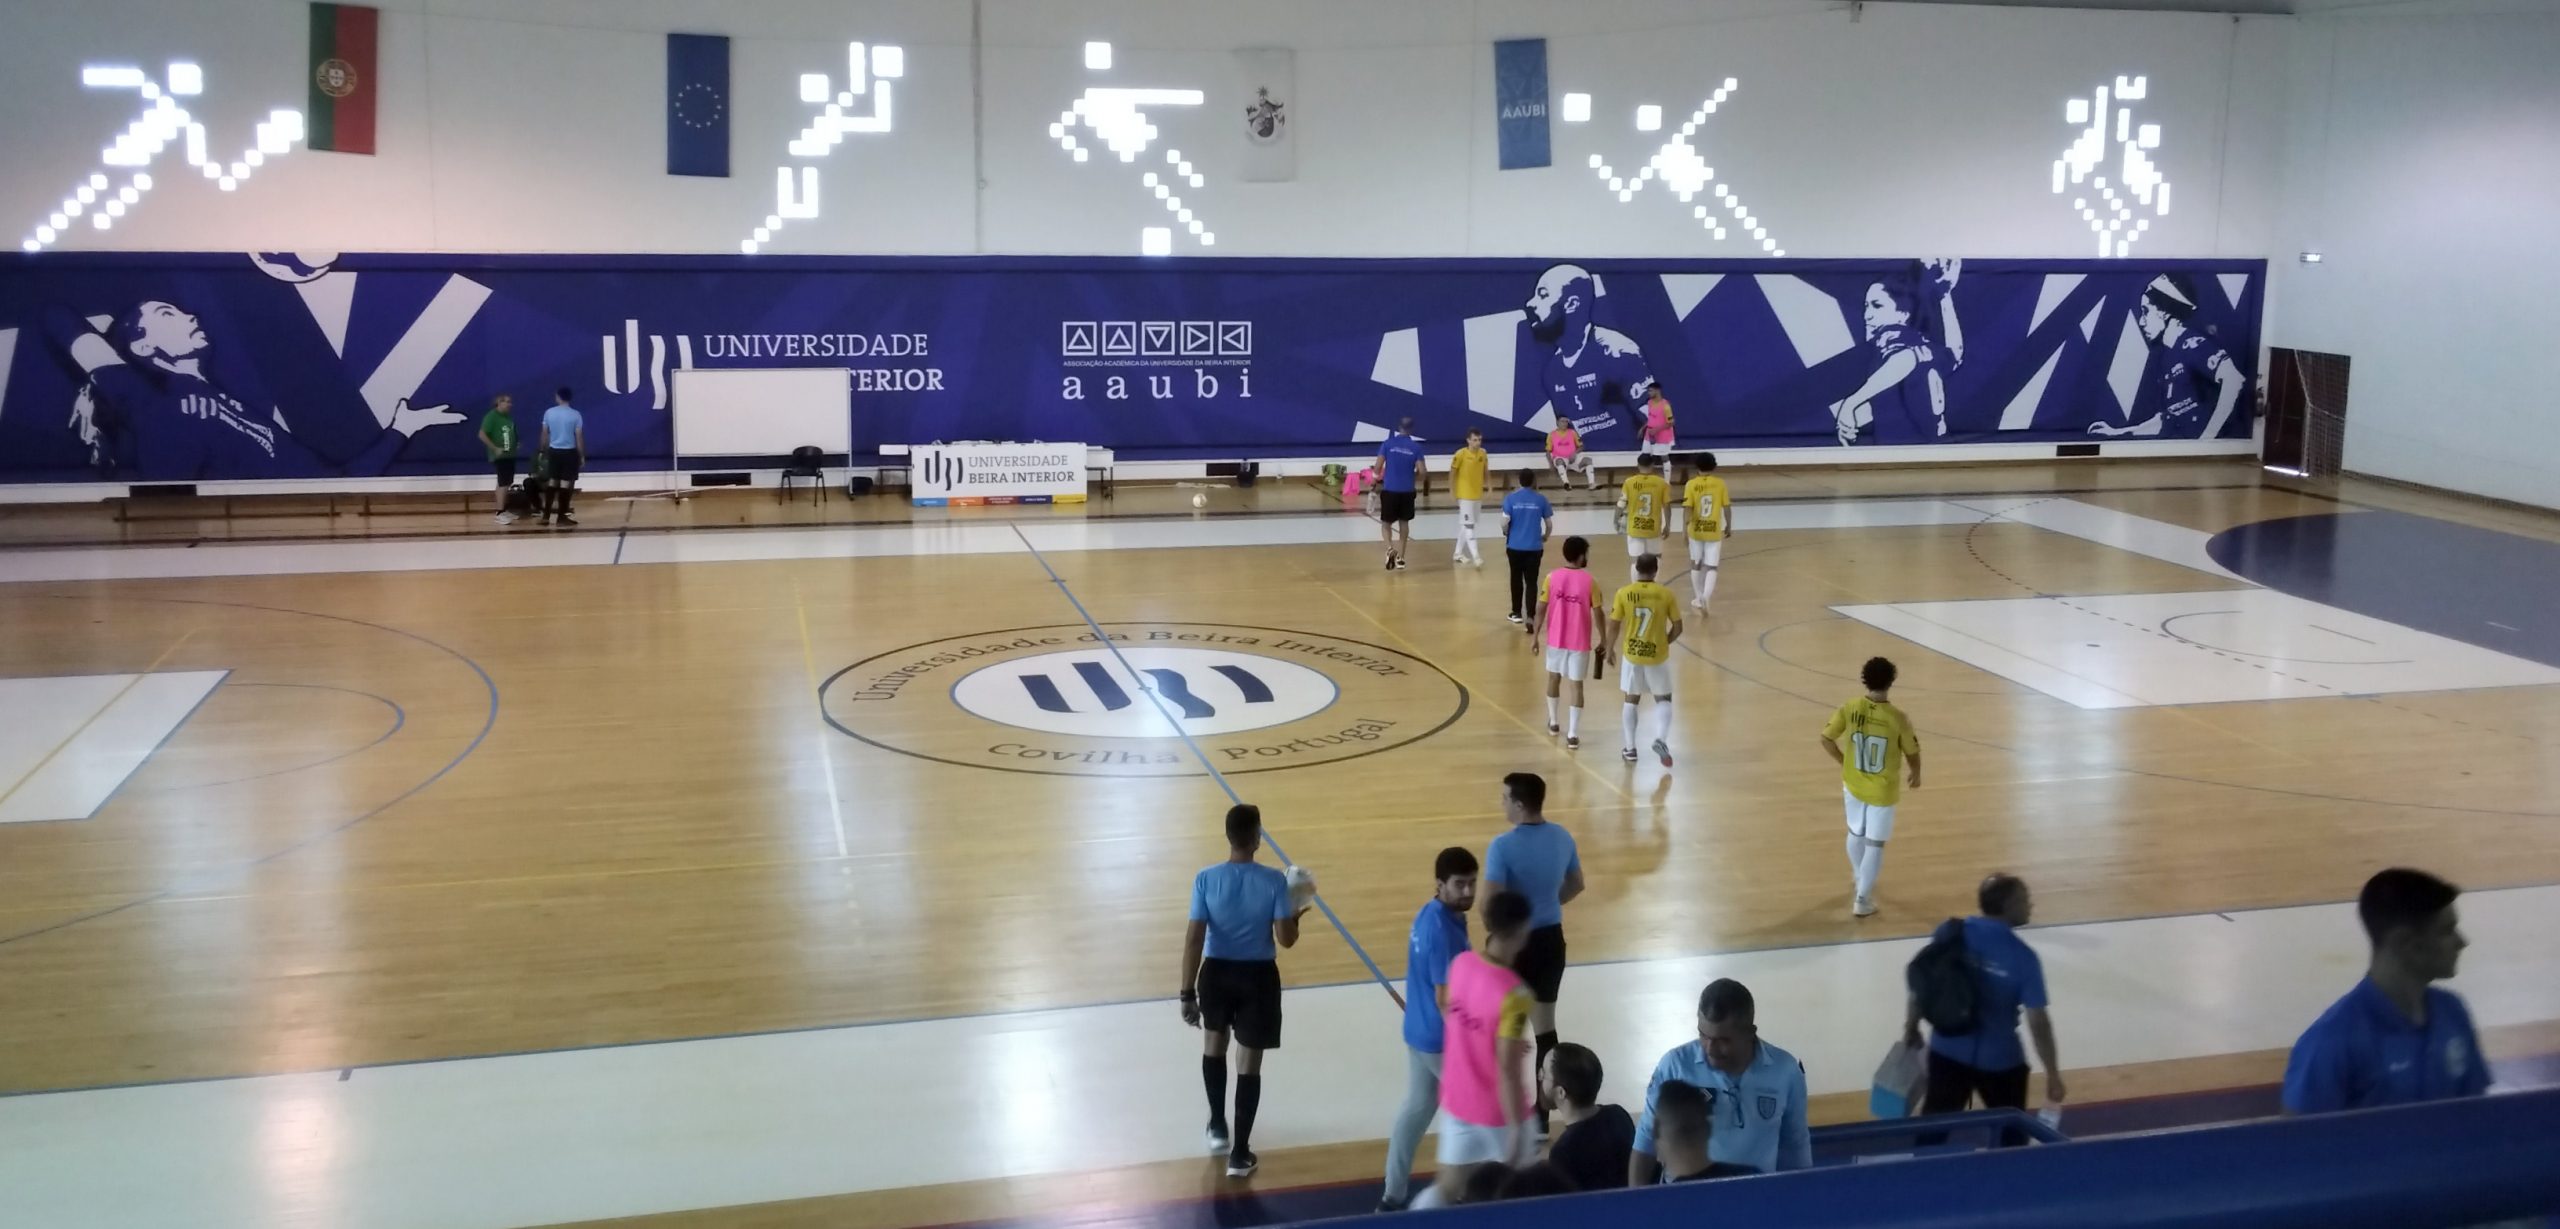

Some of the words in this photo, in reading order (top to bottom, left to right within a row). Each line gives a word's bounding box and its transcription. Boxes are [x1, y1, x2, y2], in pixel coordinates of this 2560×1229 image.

[1502, 104, 1546, 118] AAUBI
[704, 333, 929, 357] UNIVERSIDADE
[968, 455, 1069, 468] UNIVERSIDADE
[968, 473, 1009, 484] BEIRA
[1012, 471, 1075, 482] INTERIOR
[1638, 493, 1652, 517] 3
[1635, 607, 1654, 637] 7
[852, 636, 1066, 701] Universidade
[1077, 632, 1130, 643] da
[1147, 631, 1261, 645] Beira
[1270, 639, 1409, 676] Interior
[1217, 718, 1397, 760] Portugal
[1851, 731, 1888, 774] 10
